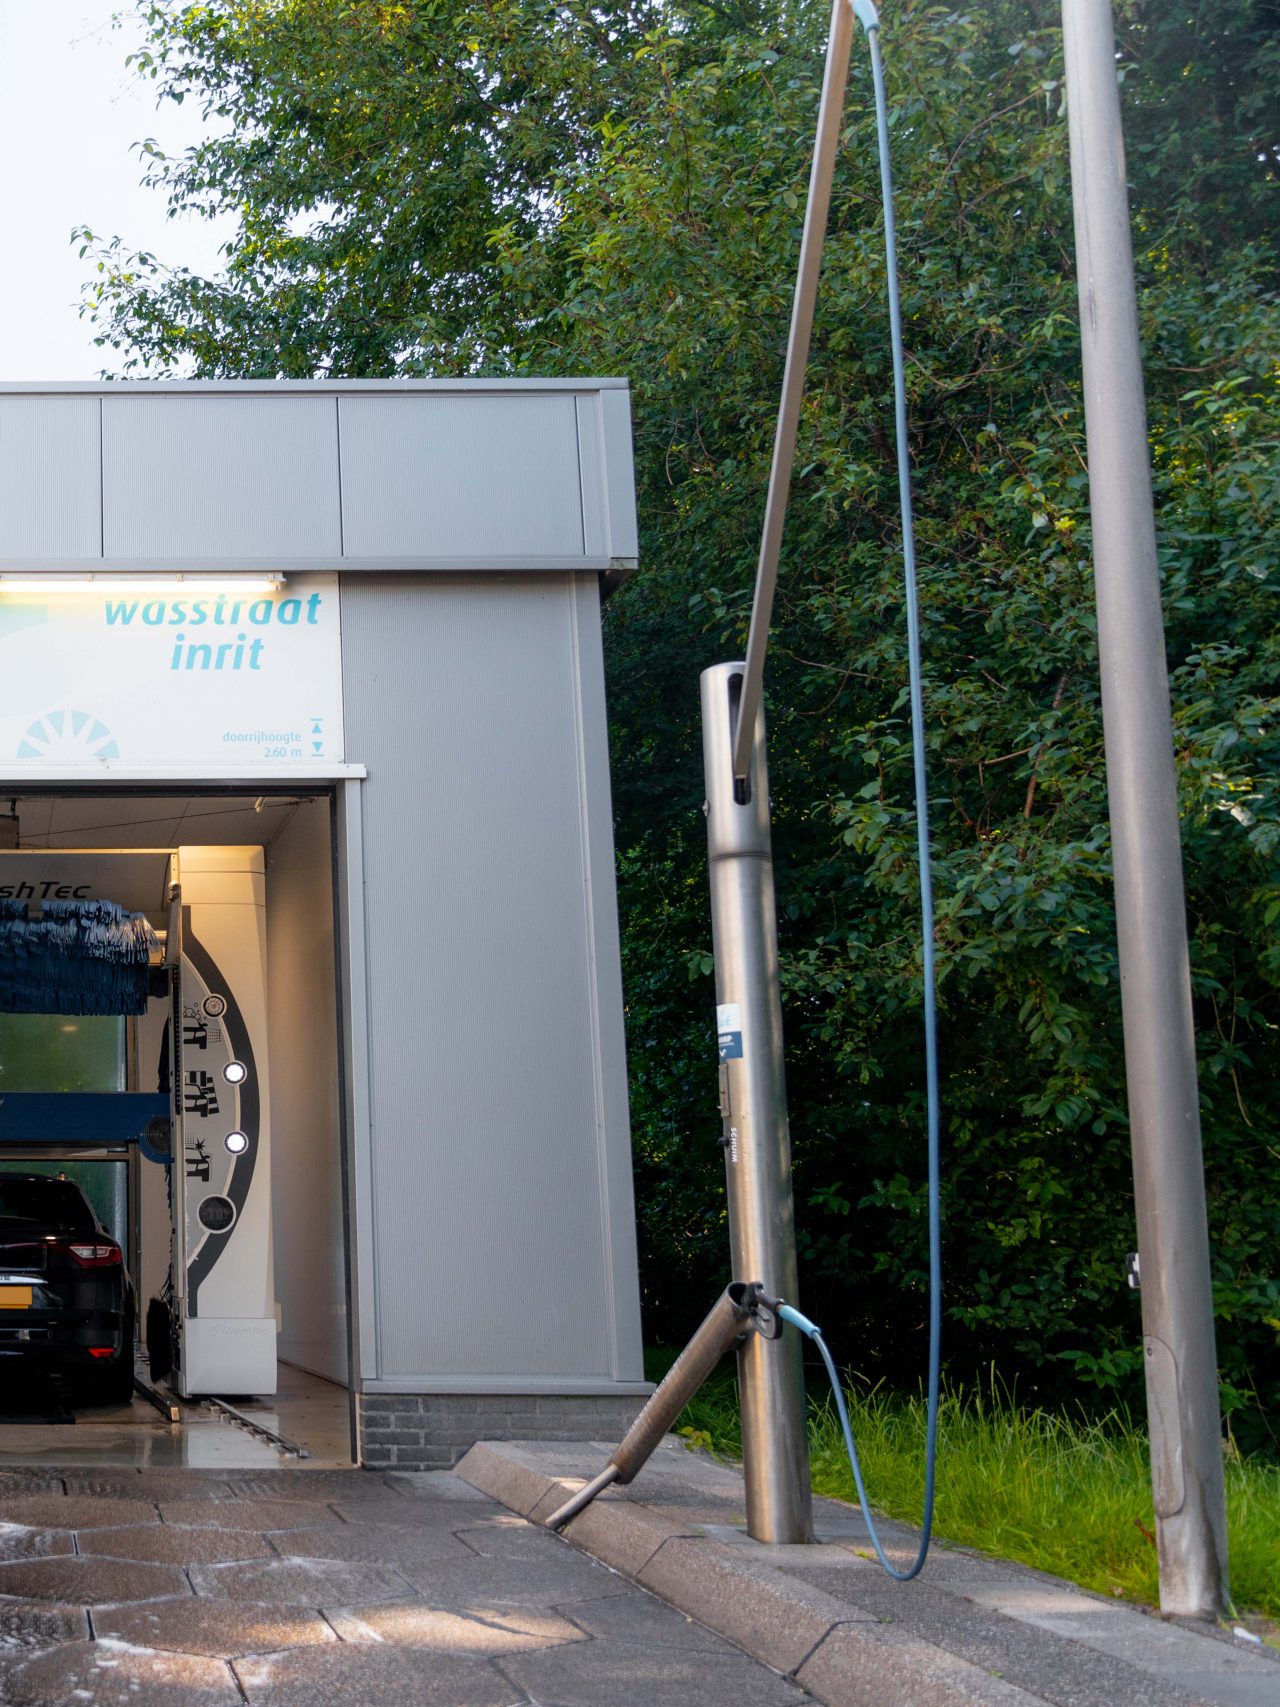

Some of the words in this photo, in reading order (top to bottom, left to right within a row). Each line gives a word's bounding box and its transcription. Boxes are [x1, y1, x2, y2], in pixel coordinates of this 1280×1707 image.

[105, 592, 322, 626] wasstraat
[170, 633, 265, 670] inrit
[223, 731, 302, 745] doorrijhoogte
[264, 746, 286, 758] 2.60
[291, 748, 302, 757] m
